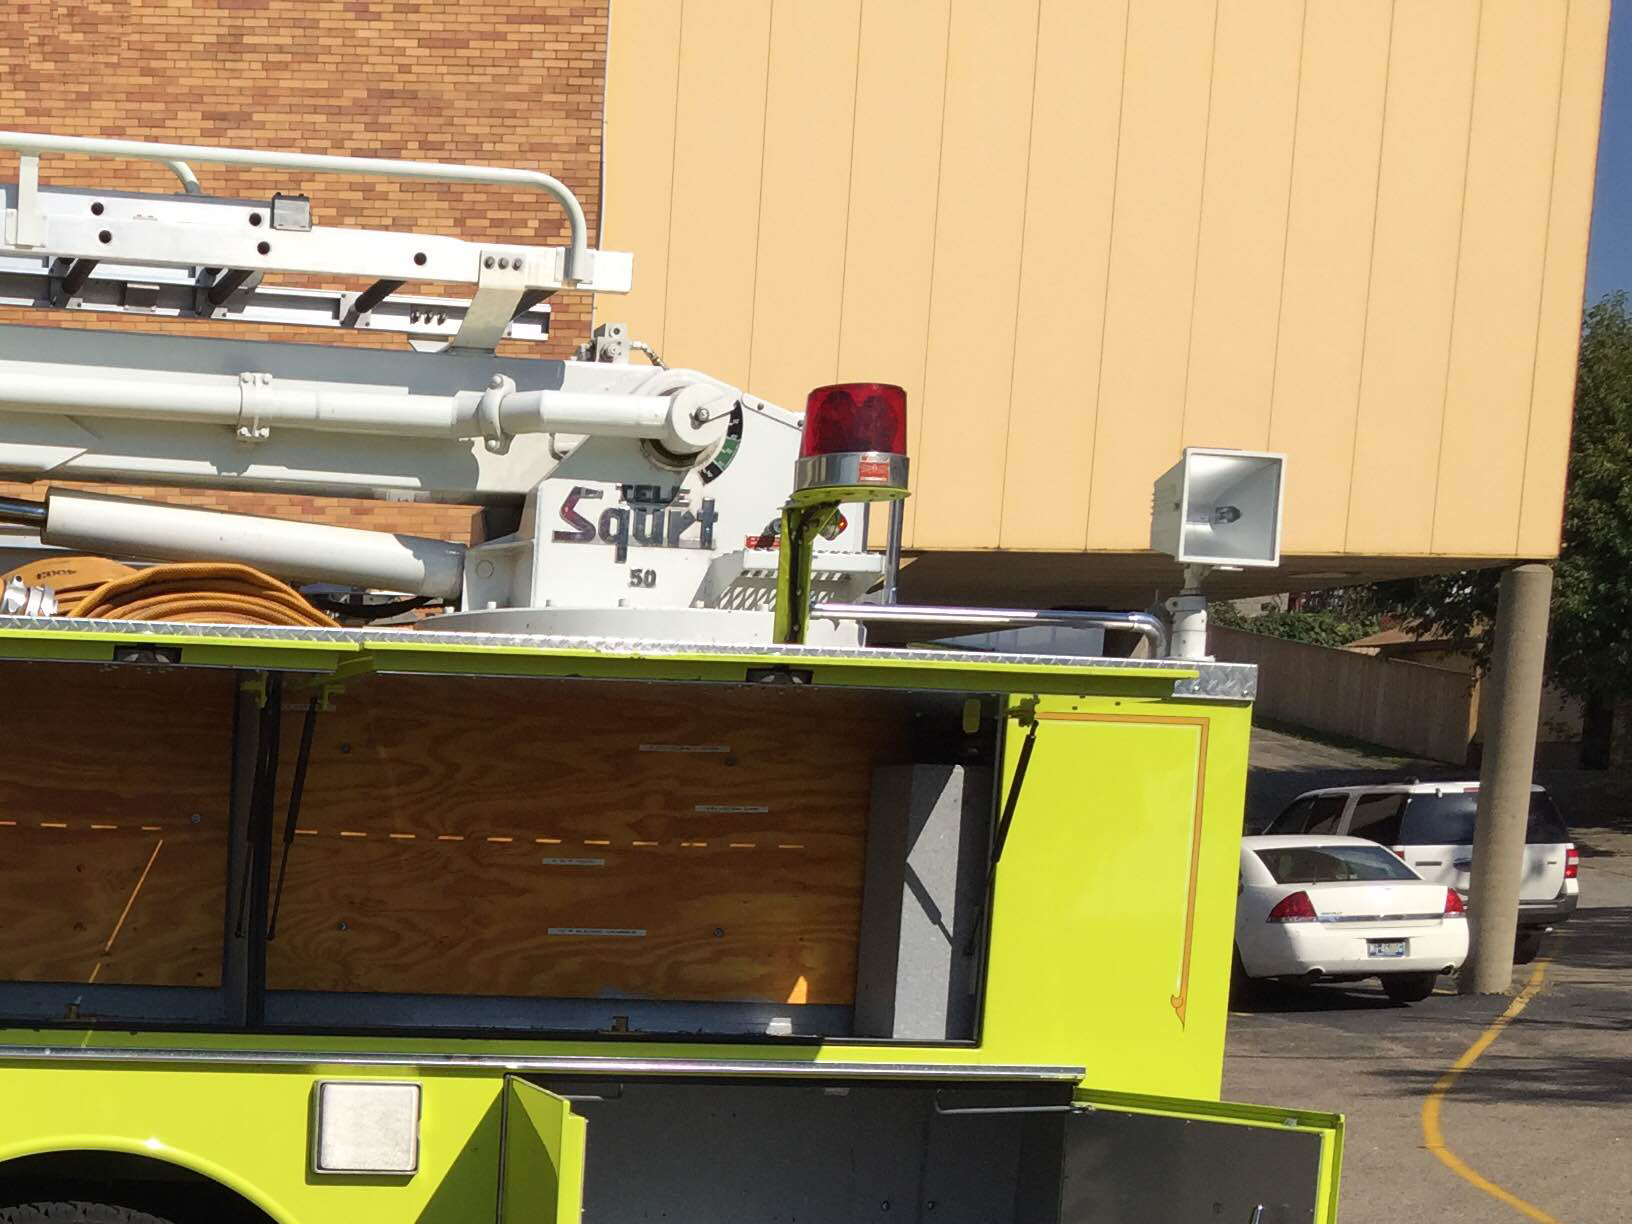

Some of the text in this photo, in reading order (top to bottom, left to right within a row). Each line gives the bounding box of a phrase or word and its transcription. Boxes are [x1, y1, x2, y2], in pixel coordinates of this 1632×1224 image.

[616, 484, 691, 507] TELE
[552, 486, 719, 564] Squrt
[629, 568, 657, 588] 50
